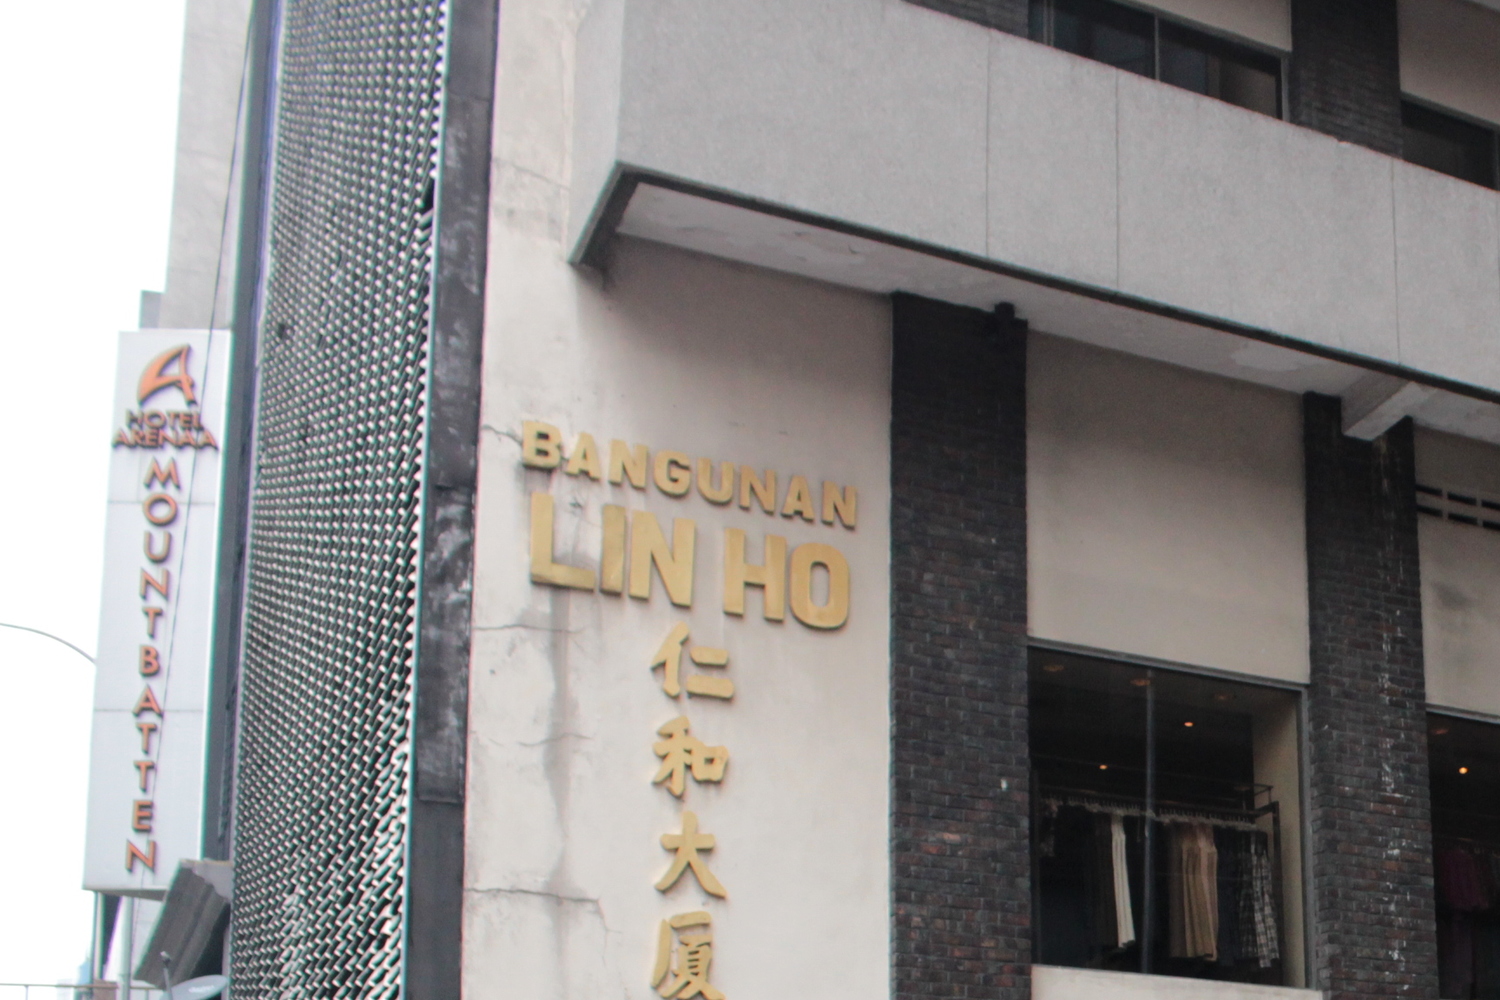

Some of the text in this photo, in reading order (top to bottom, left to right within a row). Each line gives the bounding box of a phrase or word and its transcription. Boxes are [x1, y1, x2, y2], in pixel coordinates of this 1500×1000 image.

[111, 428, 219, 450] ARENAA
[126, 408, 204, 430] HOTEL
[522, 420, 857, 531] BANGUNAN
[530, 492, 850, 630] LIN HO
[125, 456, 181, 875] MOUNTBATTEN
